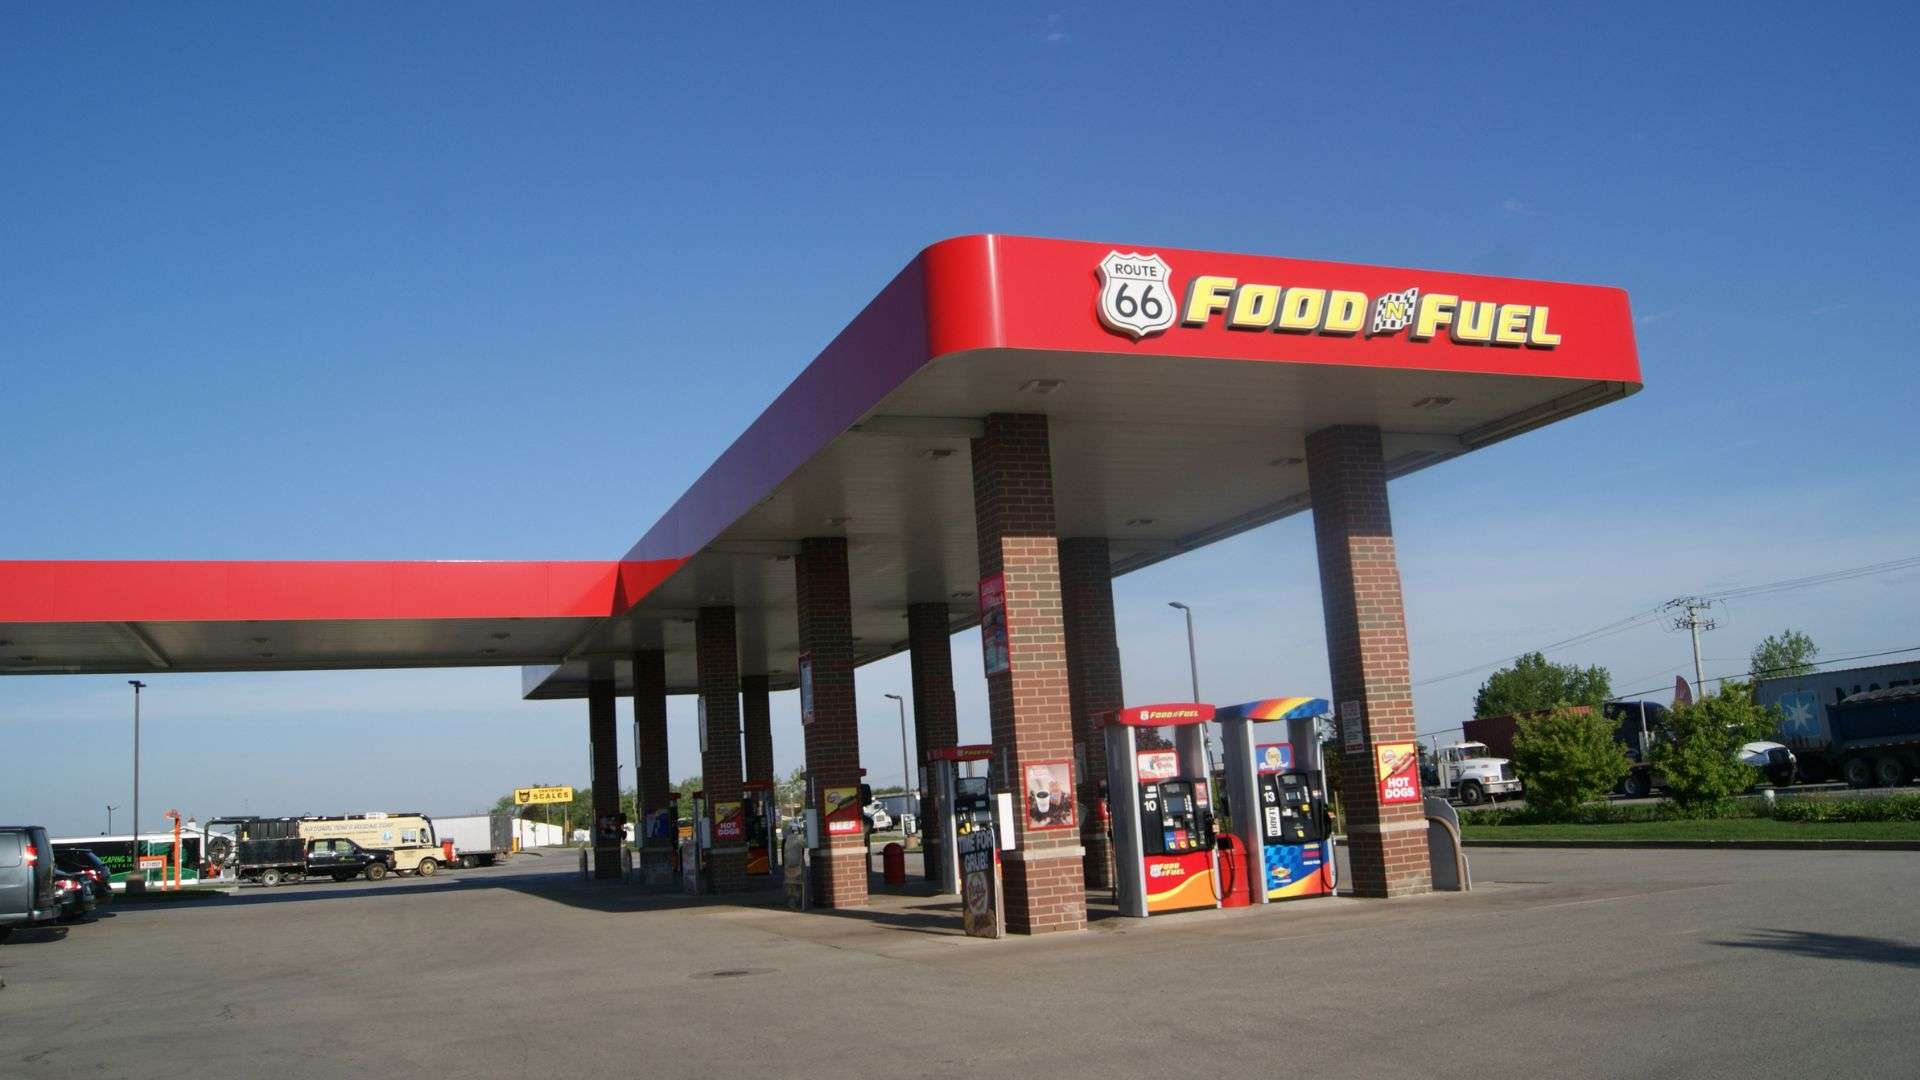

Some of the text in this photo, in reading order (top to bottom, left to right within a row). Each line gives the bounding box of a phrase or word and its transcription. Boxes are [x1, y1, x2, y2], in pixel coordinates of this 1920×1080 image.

[1115, 263, 1157, 277] ROUTE
[1115, 282, 1163, 319] 66
[1185, 275, 1562, 346] FOOD N FUEL
[1387, 777, 1410, 788] HOT
[1264, 791, 1276, 802] 13
[1384, 787, 1415, 798] DOGS
[1144, 800, 1157, 811] 10
